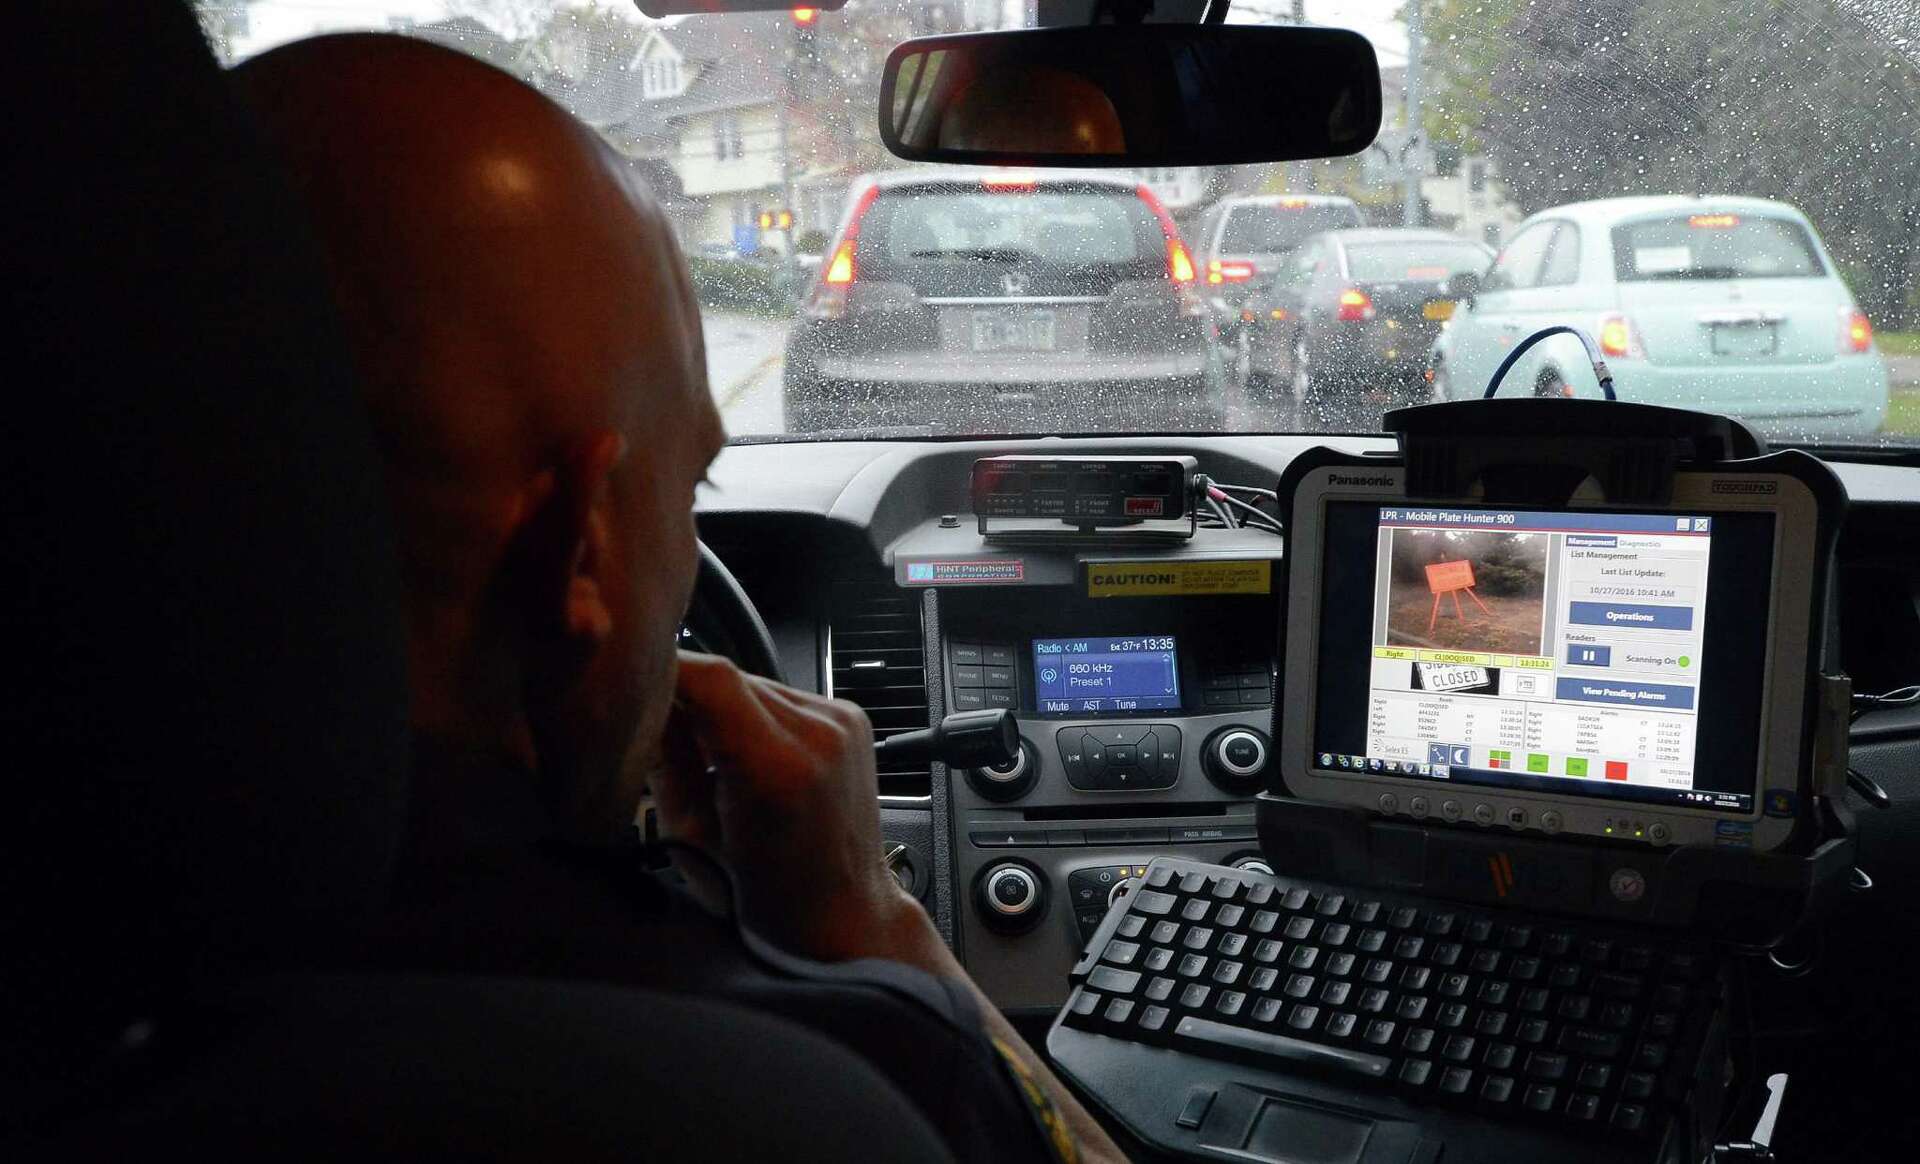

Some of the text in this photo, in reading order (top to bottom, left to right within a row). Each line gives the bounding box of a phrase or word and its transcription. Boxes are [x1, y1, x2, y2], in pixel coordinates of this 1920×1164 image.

[1328, 474, 1394, 487] Panasonic
[1716, 482, 1775, 493] TOUGHPAD
[1381, 511, 1398, 520] LPR
[1406, 512, 1437, 522] Mobile
[1439, 512, 1461, 522] Plate
[1463, 513, 1496, 523] Hunter
[1497, 514, 1515, 524] 900
[1567, 537, 1617, 546] Management
[1571, 551, 1638, 561] List Management
[1601, 568, 1617, 576] Last
[1634, 569, 1666, 578] Update:
[1094, 574, 1176, 587] CAUTION!
[1590, 586, 1675, 597] 10/27/2016 10:41 AM
[1606, 611, 1654, 623] Operations
[1566, 633, 1596, 642] Readers
[1037, 643, 1062, 654] Radio
[1073, 643, 1088, 653] AM
[1143, 638, 1174, 650] 13:35
[1386, 650, 1404, 659] Right
[1626, 655, 1677, 666] Scanning On
[1069, 663, 1113, 674] 660 kHz
[1070, 677, 1113, 687] Preset 1
[1432, 670, 1478, 688] CLOSED
[1582, 687, 1666, 700] View Pending Alarms
[1047, 701, 1070, 711] Mute
[1083, 701, 1101, 710] AST
[1115, 700, 1137, 710] Tune
